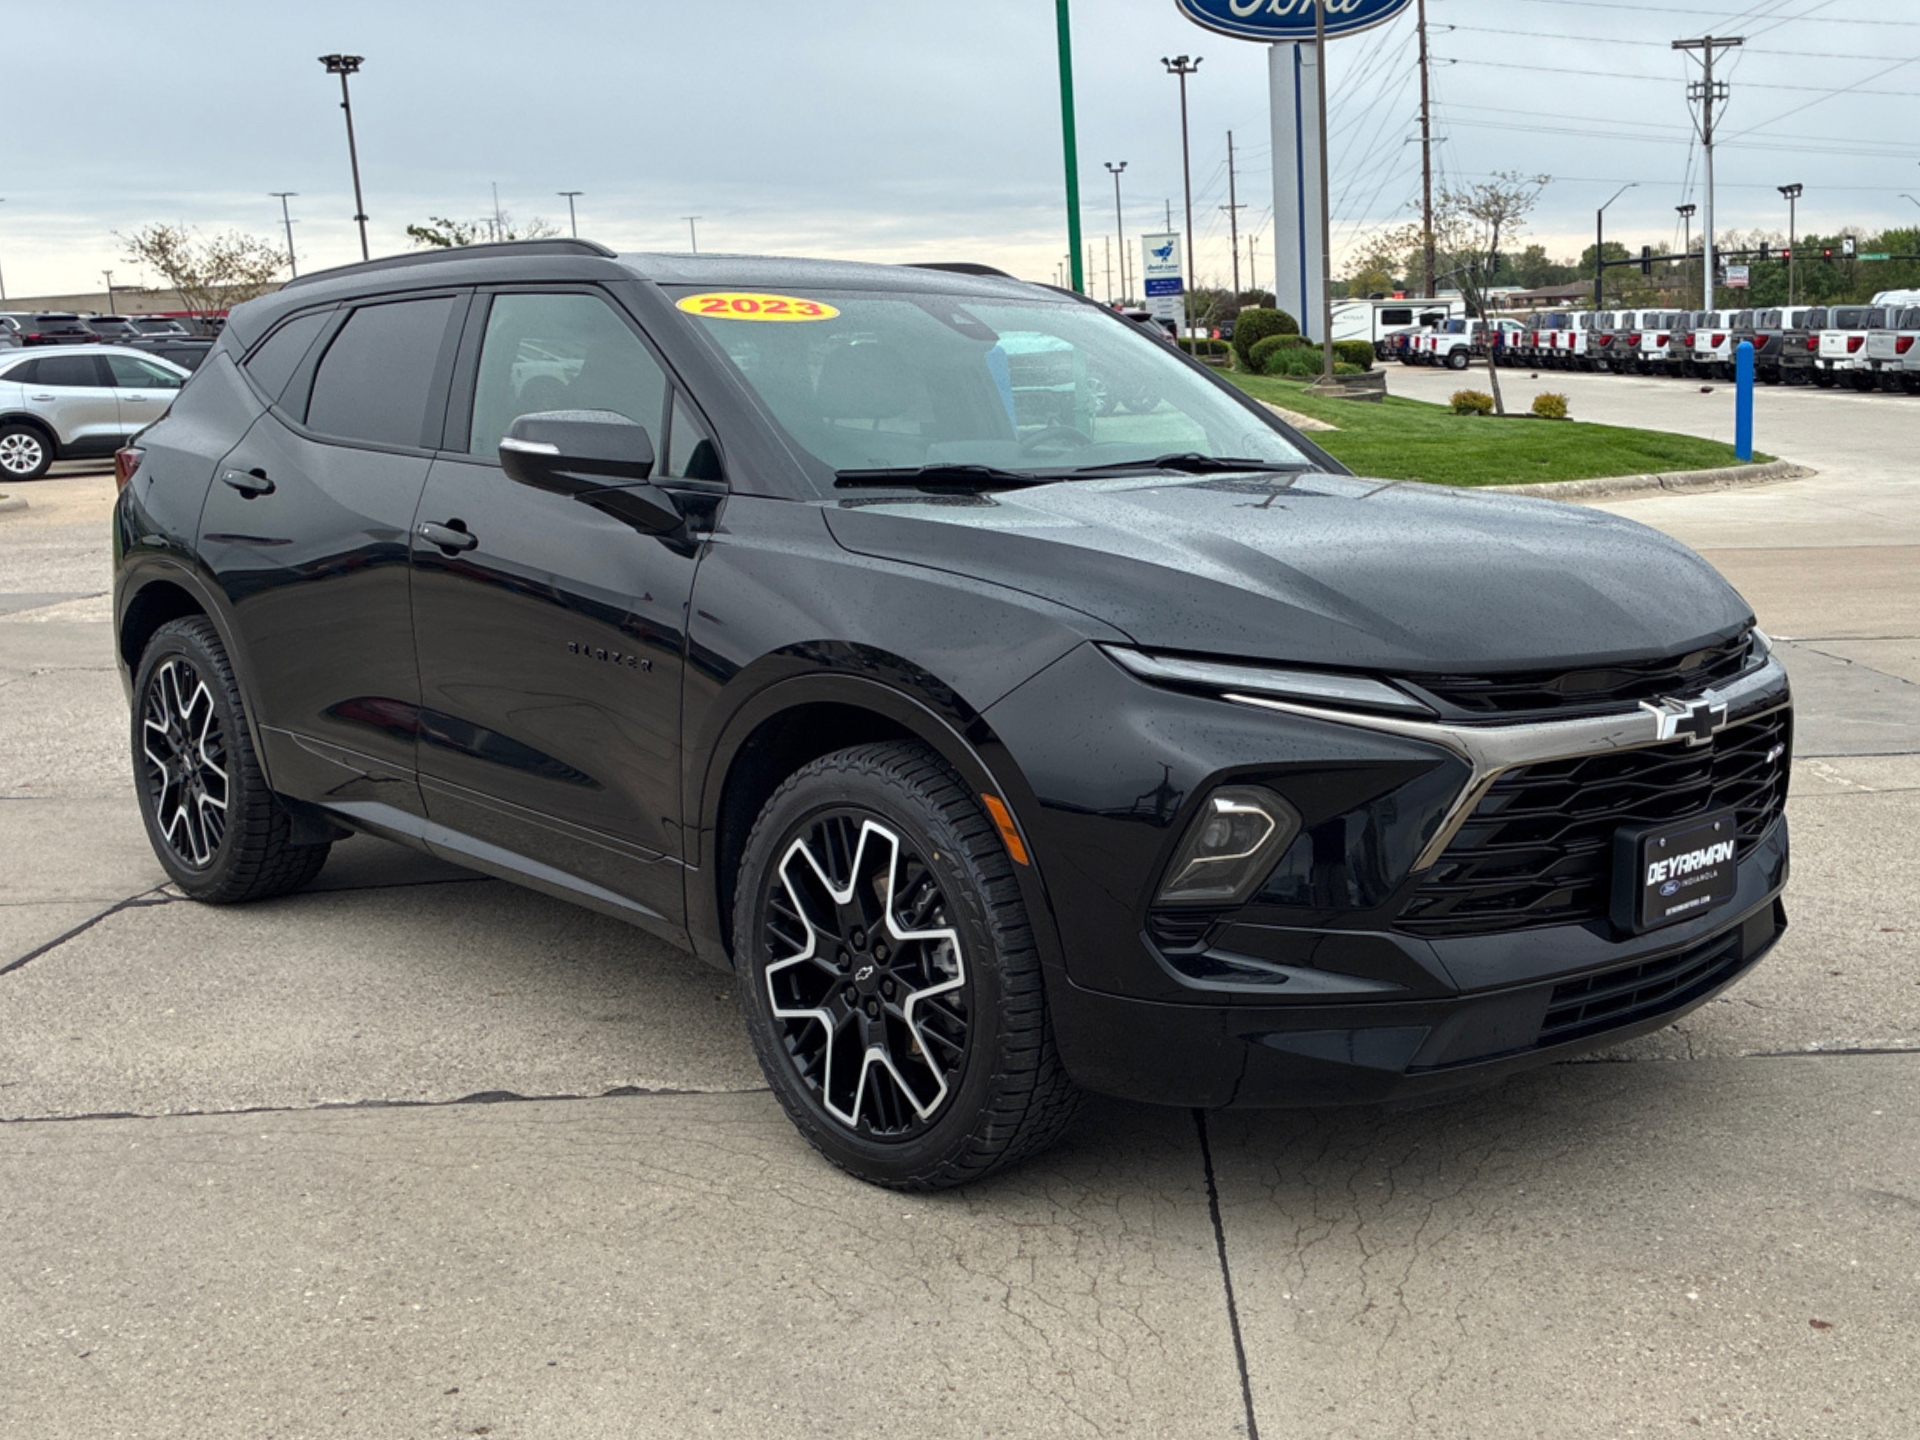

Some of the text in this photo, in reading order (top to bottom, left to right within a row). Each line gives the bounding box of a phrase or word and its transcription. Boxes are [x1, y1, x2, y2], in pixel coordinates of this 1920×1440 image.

[699, 298, 825, 316] 2023
[568, 642, 653, 673] BLAZER
[1646, 840, 1734, 886] DEYARMAN
